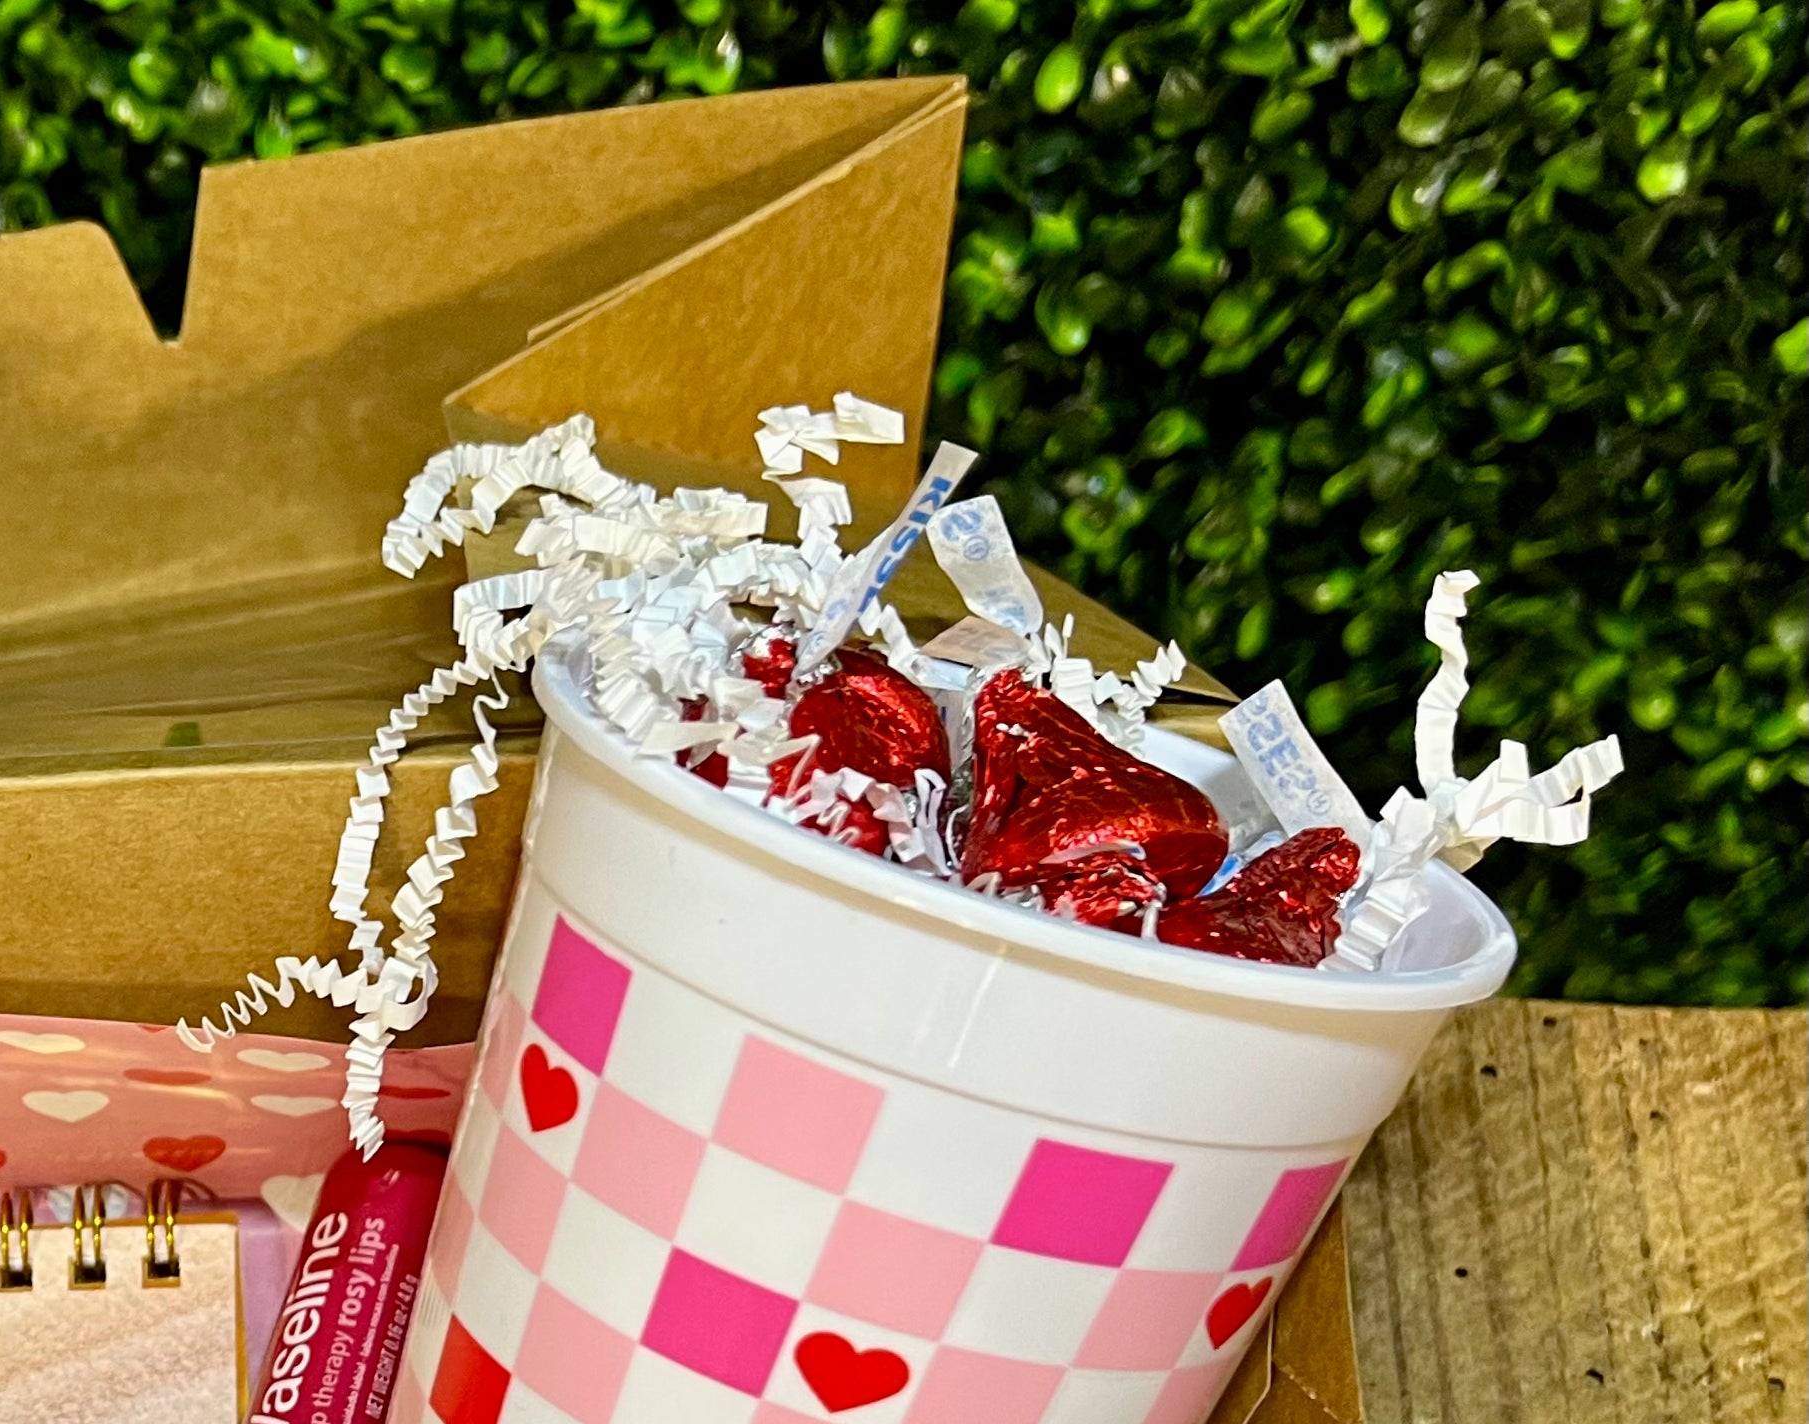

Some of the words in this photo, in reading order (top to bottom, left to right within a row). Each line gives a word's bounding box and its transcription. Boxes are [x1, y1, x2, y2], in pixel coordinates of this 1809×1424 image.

[348, 1217, 387, 1265] lips
[337, 1268, 376, 1328] rosy
[312, 1330, 355, 1408] therapy
[372, 1347, 397, 1396] WEIGHT
[365, 1392, 385, 1419] NET
